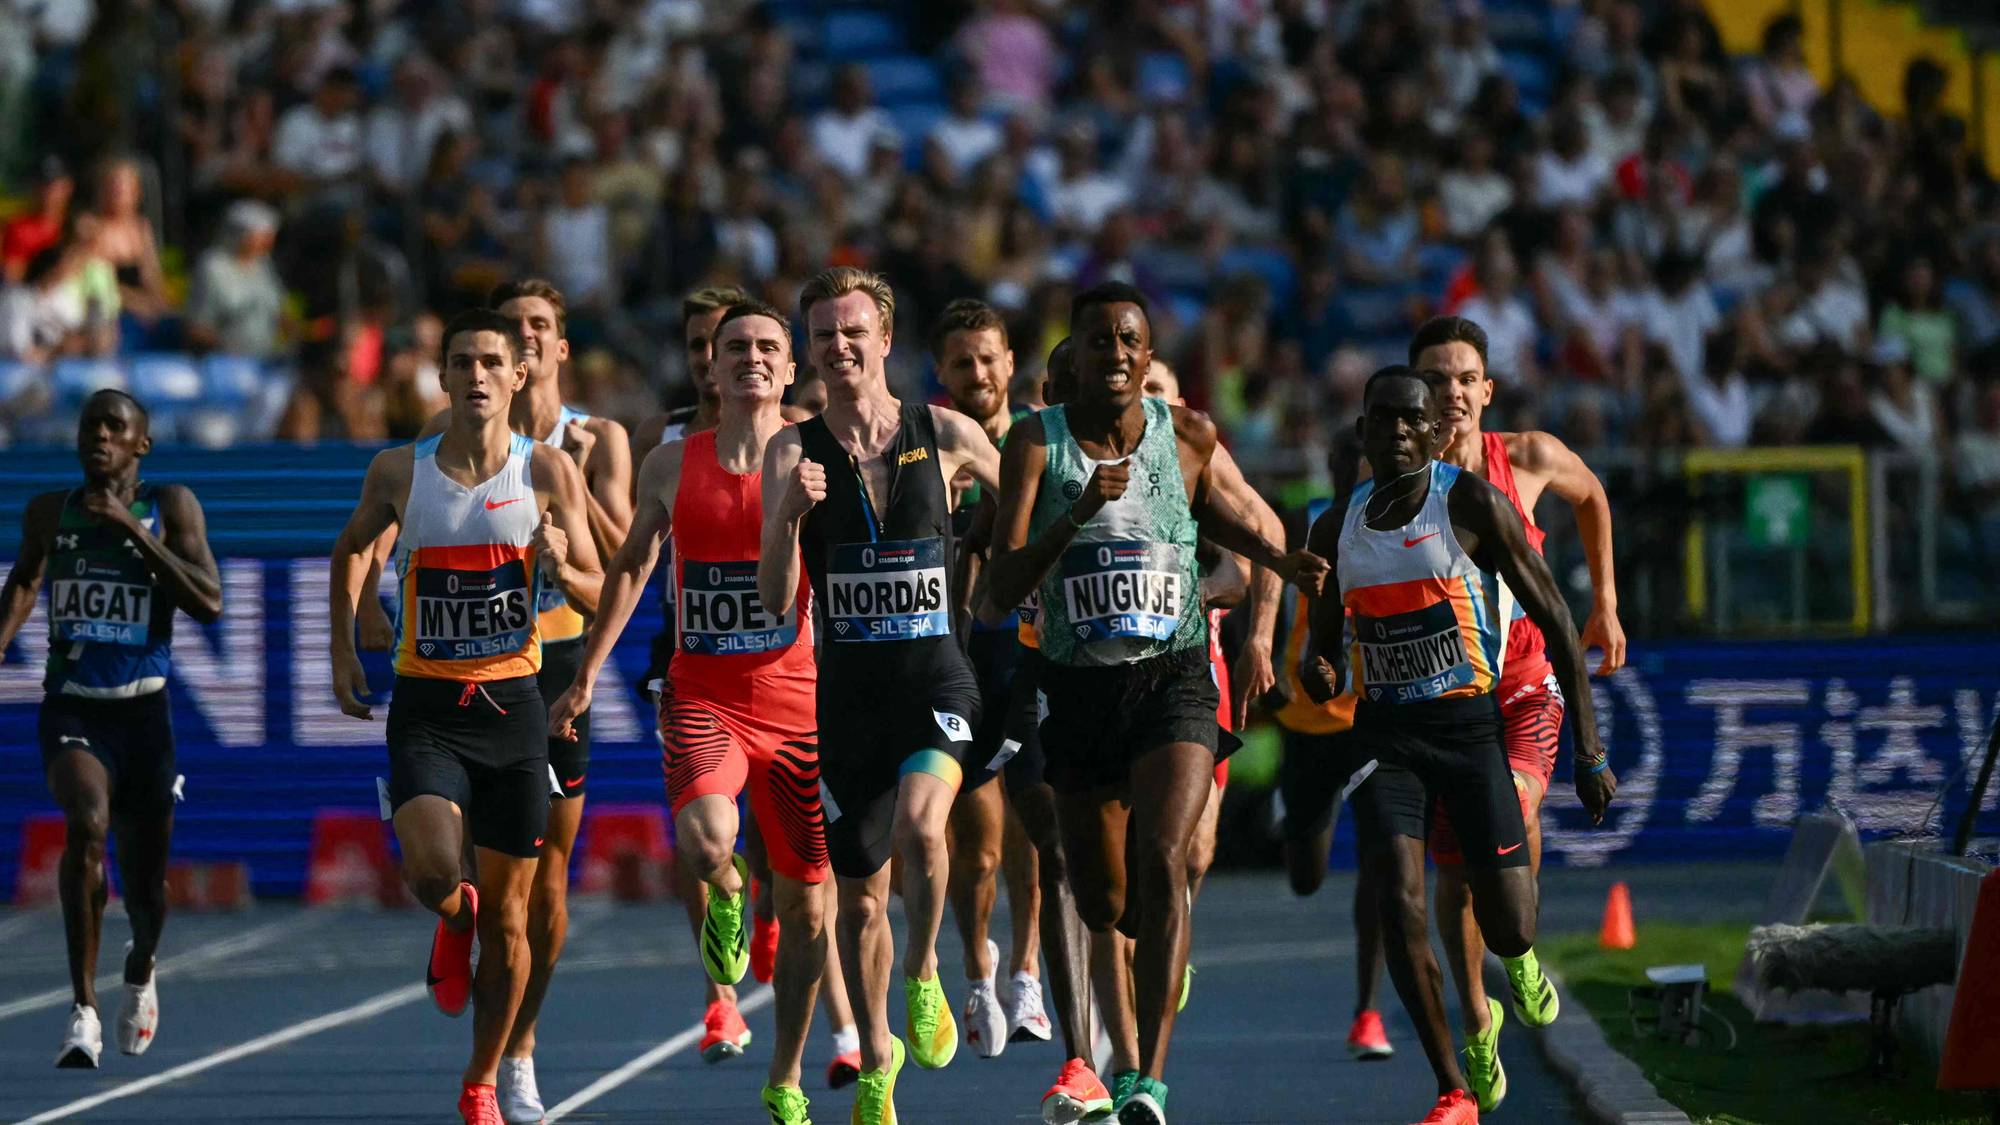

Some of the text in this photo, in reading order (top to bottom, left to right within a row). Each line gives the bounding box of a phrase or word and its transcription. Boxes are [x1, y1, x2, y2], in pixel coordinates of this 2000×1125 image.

[898, 447, 928, 465] HOKA
[54, 582, 149, 623] LAGAT
[832, 571, 941, 615] NORDÅS
[1072, 573, 1175, 619] NUGUSE
[420, 591, 528, 637] MYERS
[685, 592, 785, 631] HOE
[1110, 616, 1166, 635] SILESIA
[72, 623, 132, 641] SILESIA
[870, 618, 933, 635] SILESIA
[455, 636, 519, 657] SILESIA
[717, 632, 782, 651] SILESIA
[1362, 629, 1463, 682] R. CHERUIYOT
[1397, 672, 1460, 700] SILESIA
[946, 716, 960, 732] 8
[1683, 676, 1946, 833] 万达
